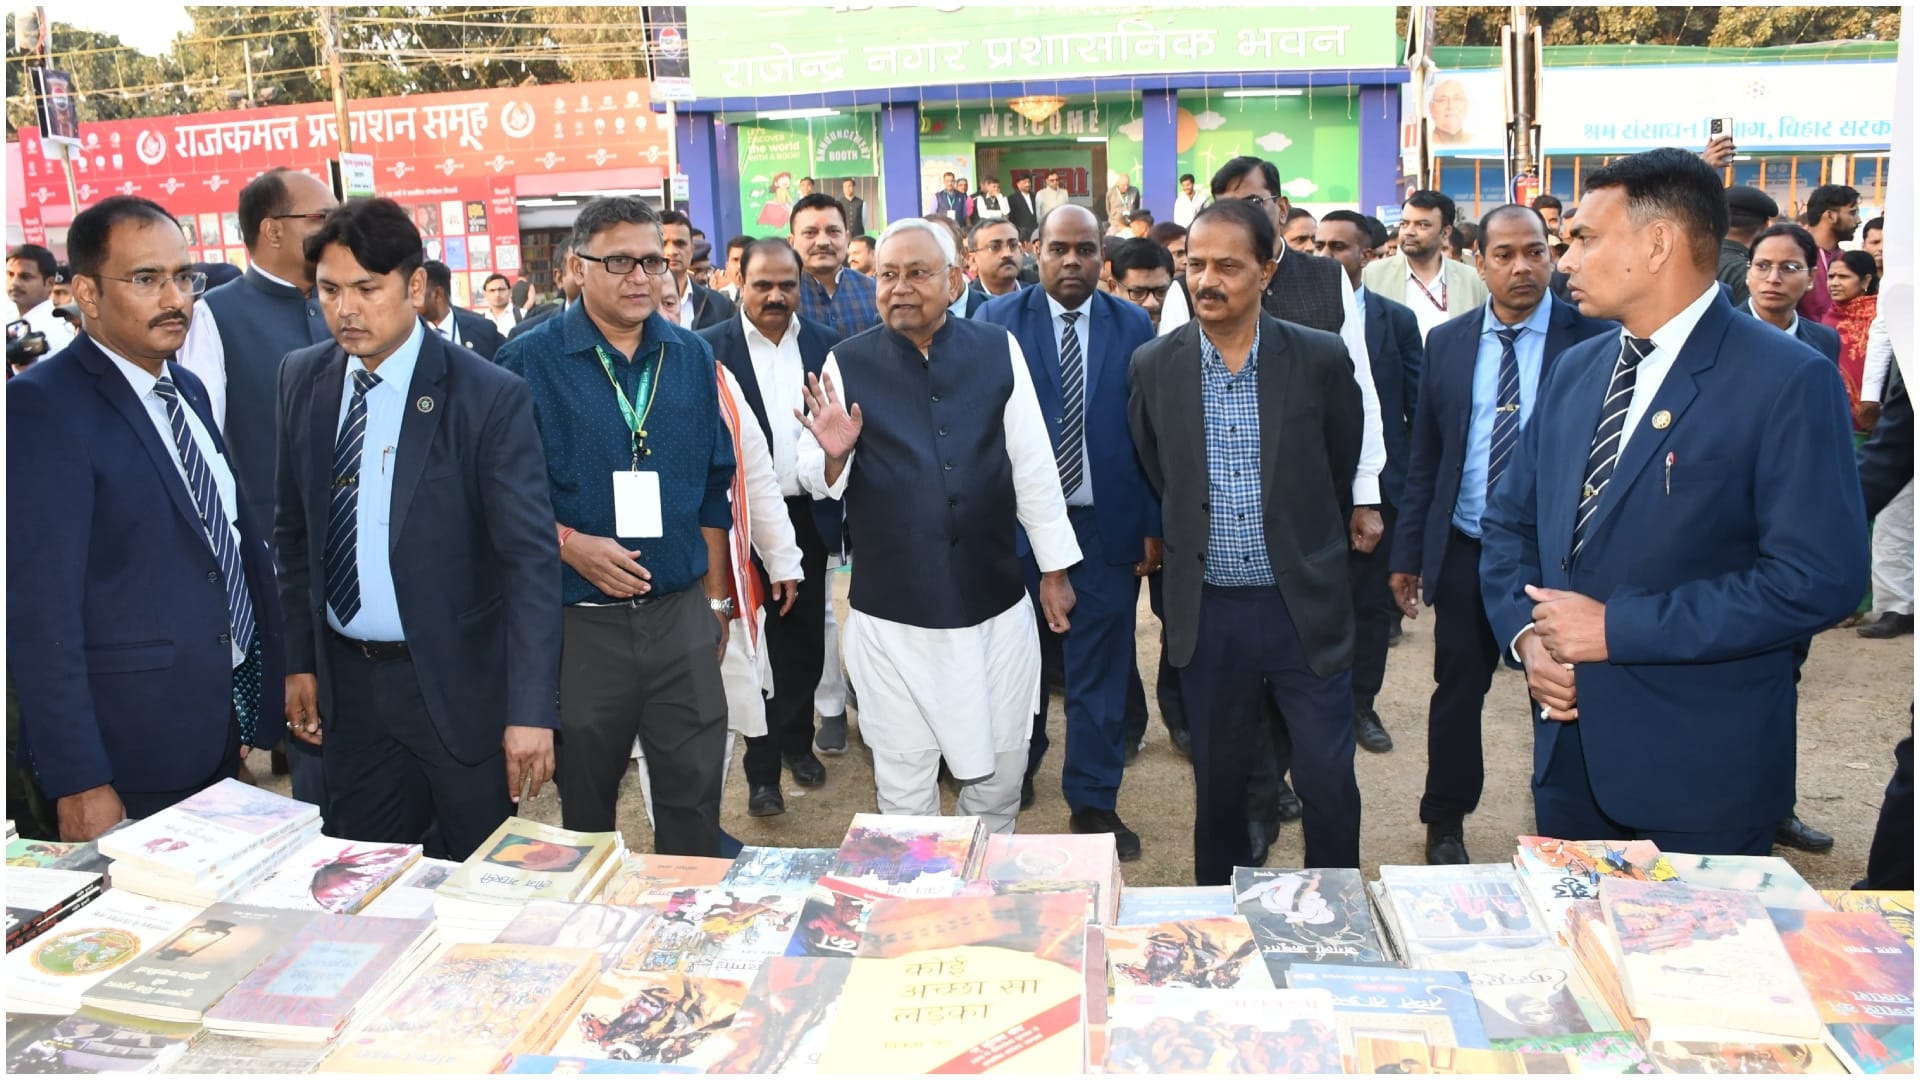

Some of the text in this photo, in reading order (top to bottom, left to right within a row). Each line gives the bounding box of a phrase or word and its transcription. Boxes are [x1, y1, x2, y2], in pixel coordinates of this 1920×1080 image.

[719, 44, 848, 89] राजेन्द्र
[864, 41, 969, 75] नगर
[983, 22, 1216, 69] प्रशासनिक
[1237, 24, 1350, 58] भवन
[175, 116, 298, 157] राजकमल
[422, 102, 489, 150] समूह
[979, 109, 1099, 137] WELCOME
[1583, 122, 1615, 140] श्रम
[1622, 119, 1697, 140] संसाधन
[1839, 119, 1892, 137] सरक
[768, 141, 800, 152] world
[829, 149, 858, 161] BOOTH
[904, 955, 968, 977] कोई
[900, 979, 1044, 999] अच्छा सा
